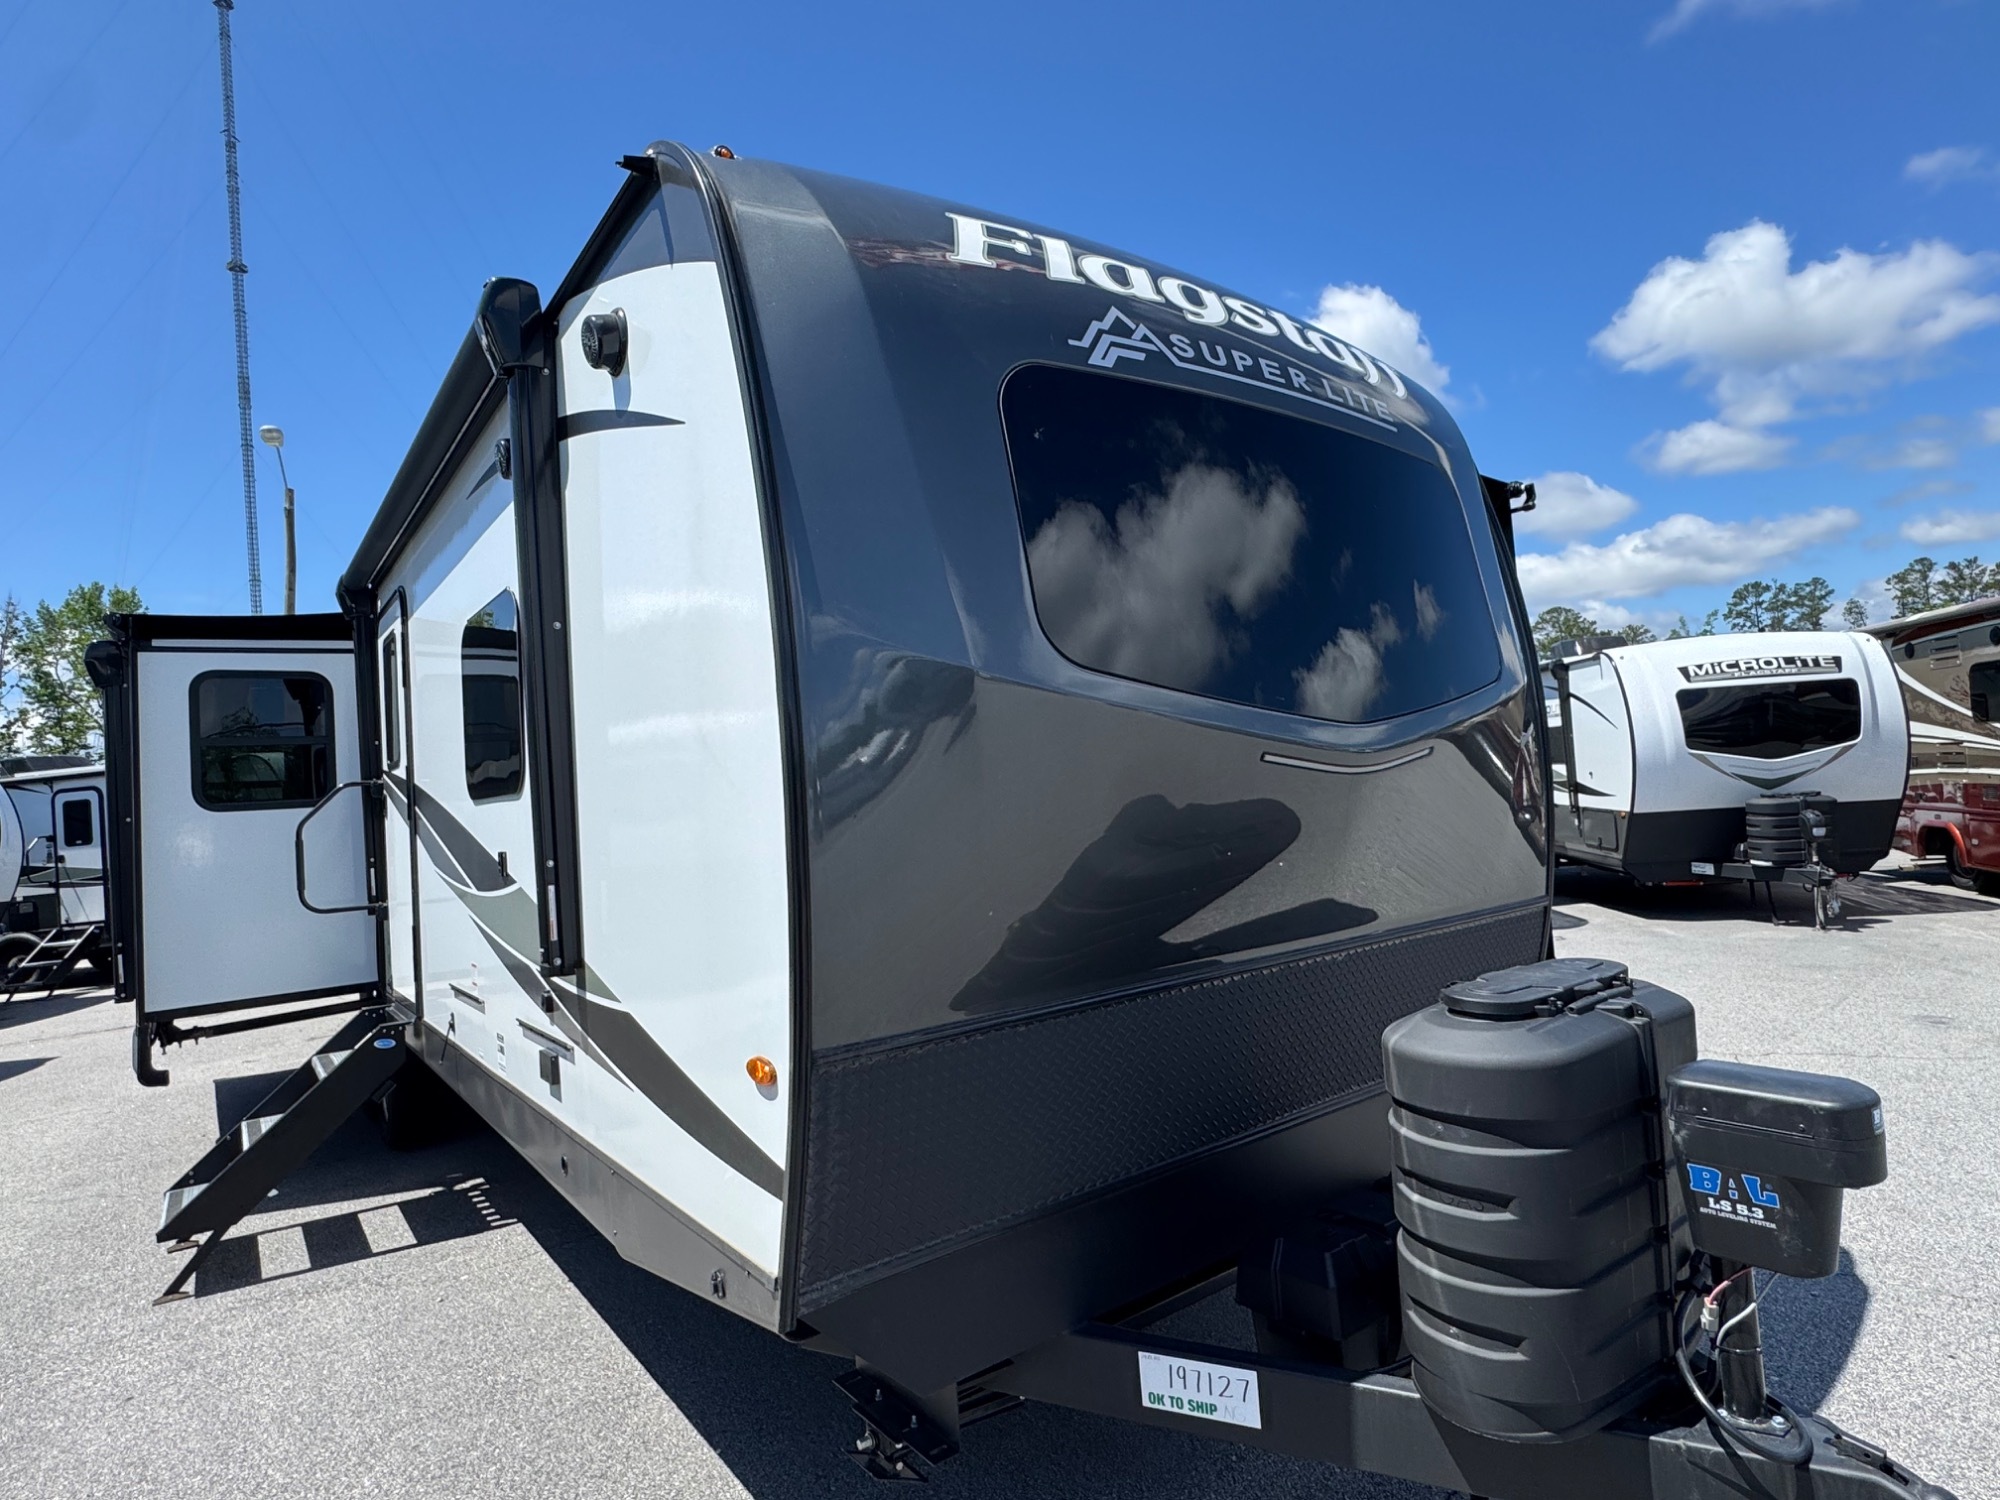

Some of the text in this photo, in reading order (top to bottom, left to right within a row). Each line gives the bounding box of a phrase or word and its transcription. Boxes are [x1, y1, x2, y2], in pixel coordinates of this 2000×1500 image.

[1169, 334, 1394, 422] SUPER LITE
[1734, 668, 1799, 677] FLAGSTAFF
[1687, 1163, 1780, 1209] BAL
[1707, 1197, 1764, 1219] LS 5.3
[1750, 1218, 1777, 1229] SYSTEM
[1168, 1364, 1250, 1403] 197127
[1148, 1392, 1218, 1416] OK TO SHIP
